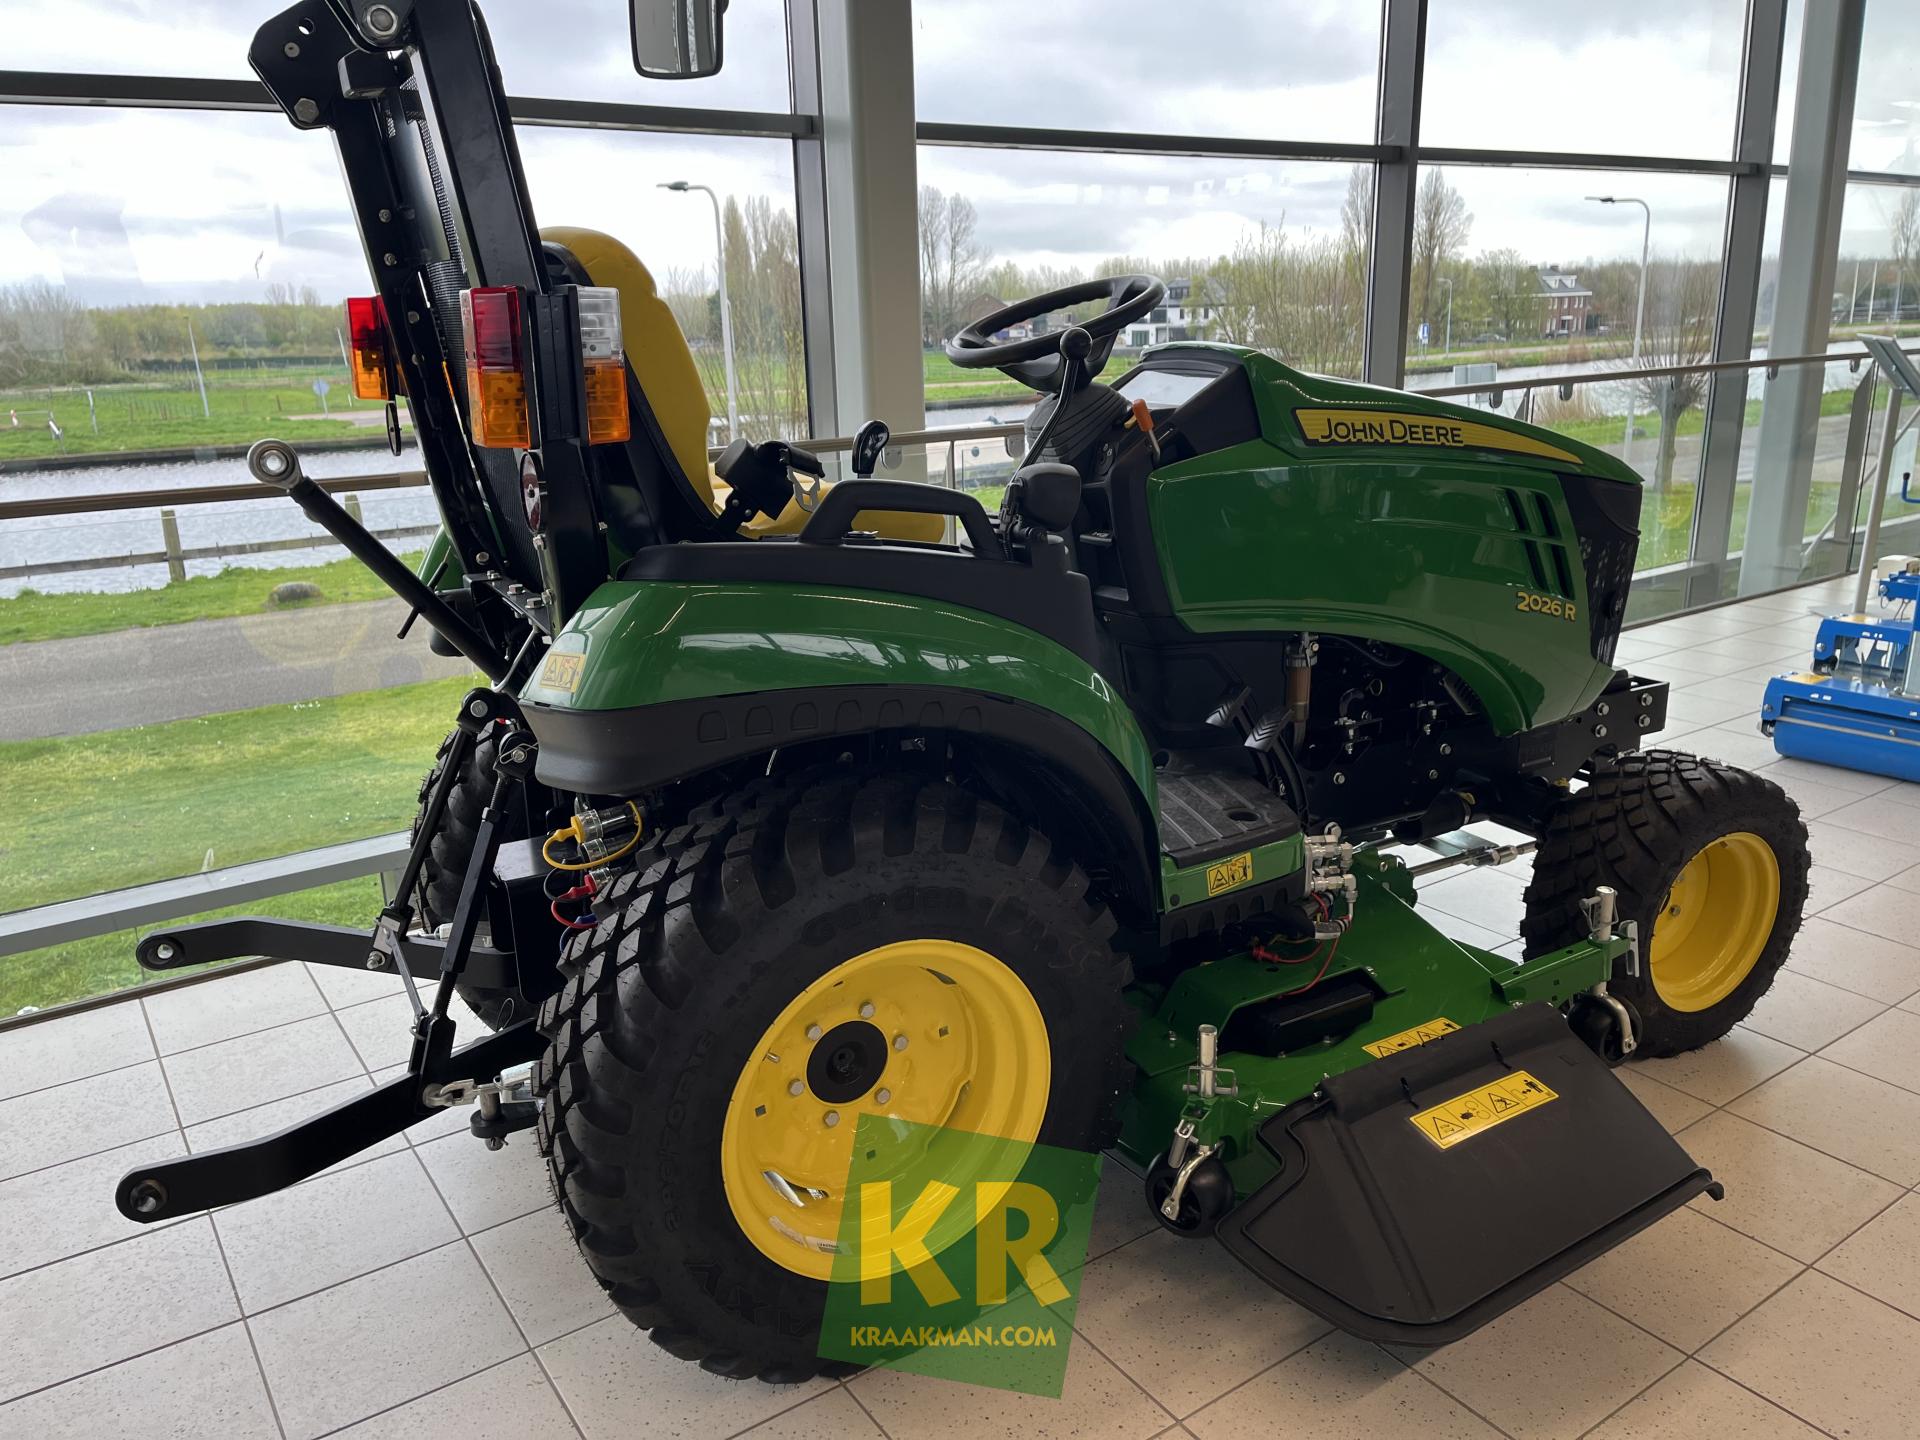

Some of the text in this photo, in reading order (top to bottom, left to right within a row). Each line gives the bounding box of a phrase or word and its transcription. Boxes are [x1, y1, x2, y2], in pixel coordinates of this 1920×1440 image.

[1320, 417, 1464, 444] JOHN DEERE
[1516, 591, 1562, 617] 2026
